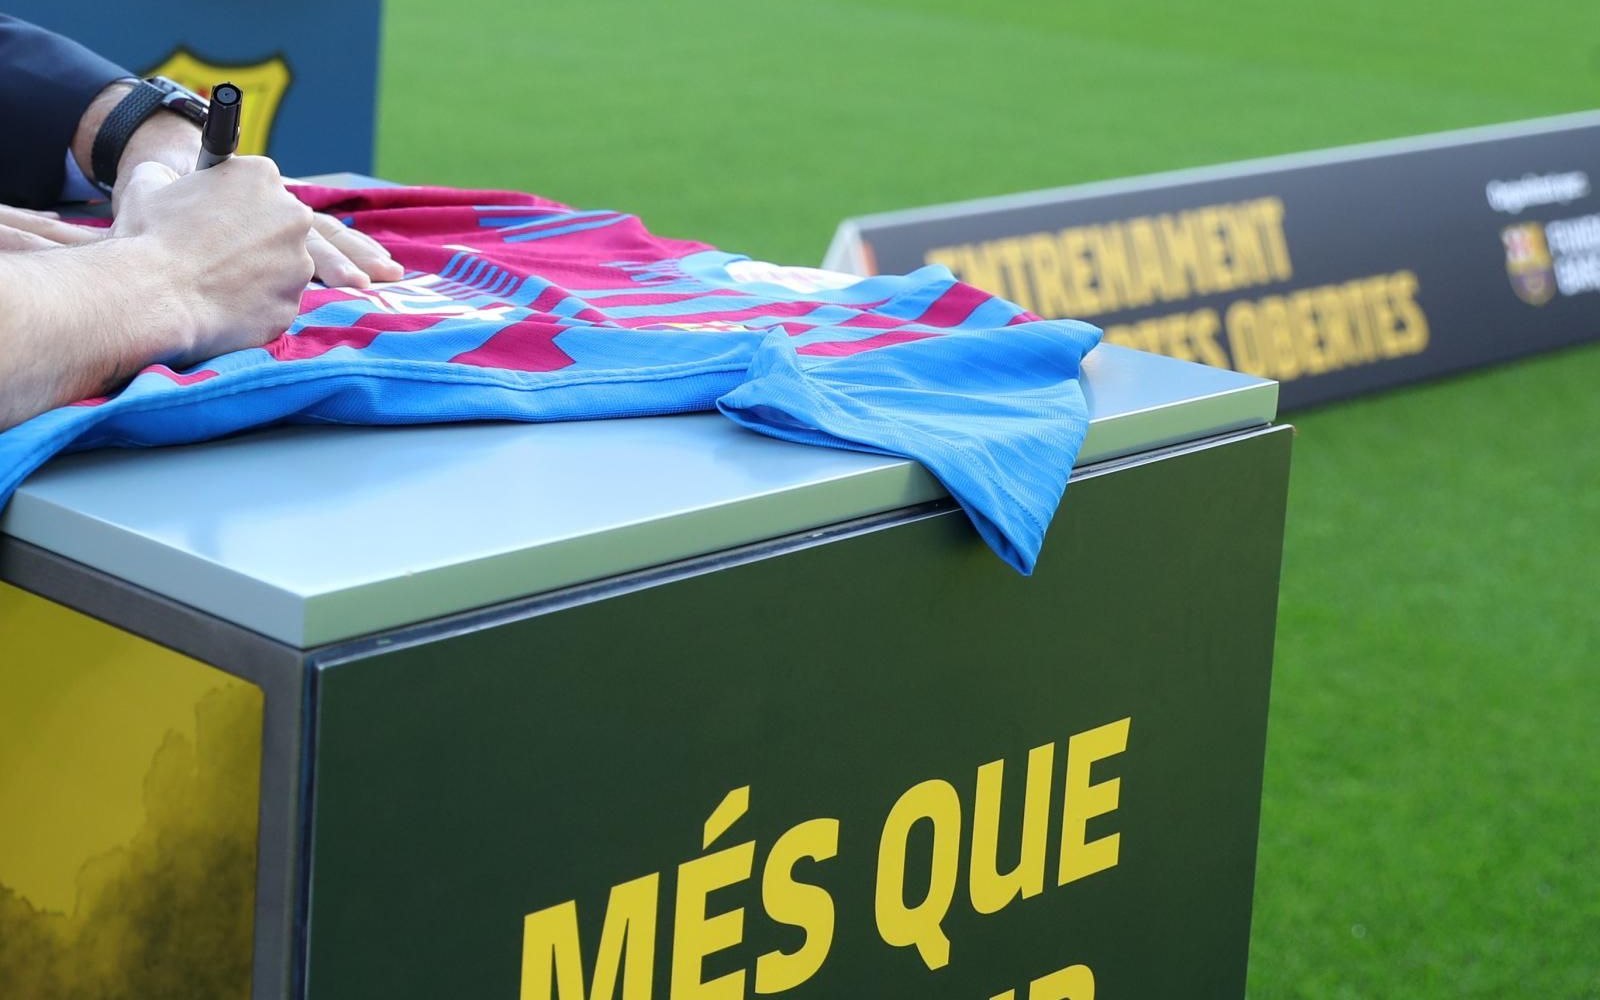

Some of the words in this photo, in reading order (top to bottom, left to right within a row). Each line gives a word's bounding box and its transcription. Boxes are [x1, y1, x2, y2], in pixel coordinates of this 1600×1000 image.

[1225, 270, 1430, 381] OBERTES
[518, 785, 839, 1000] MÉS
[875, 717, 1131, 971] QUE
